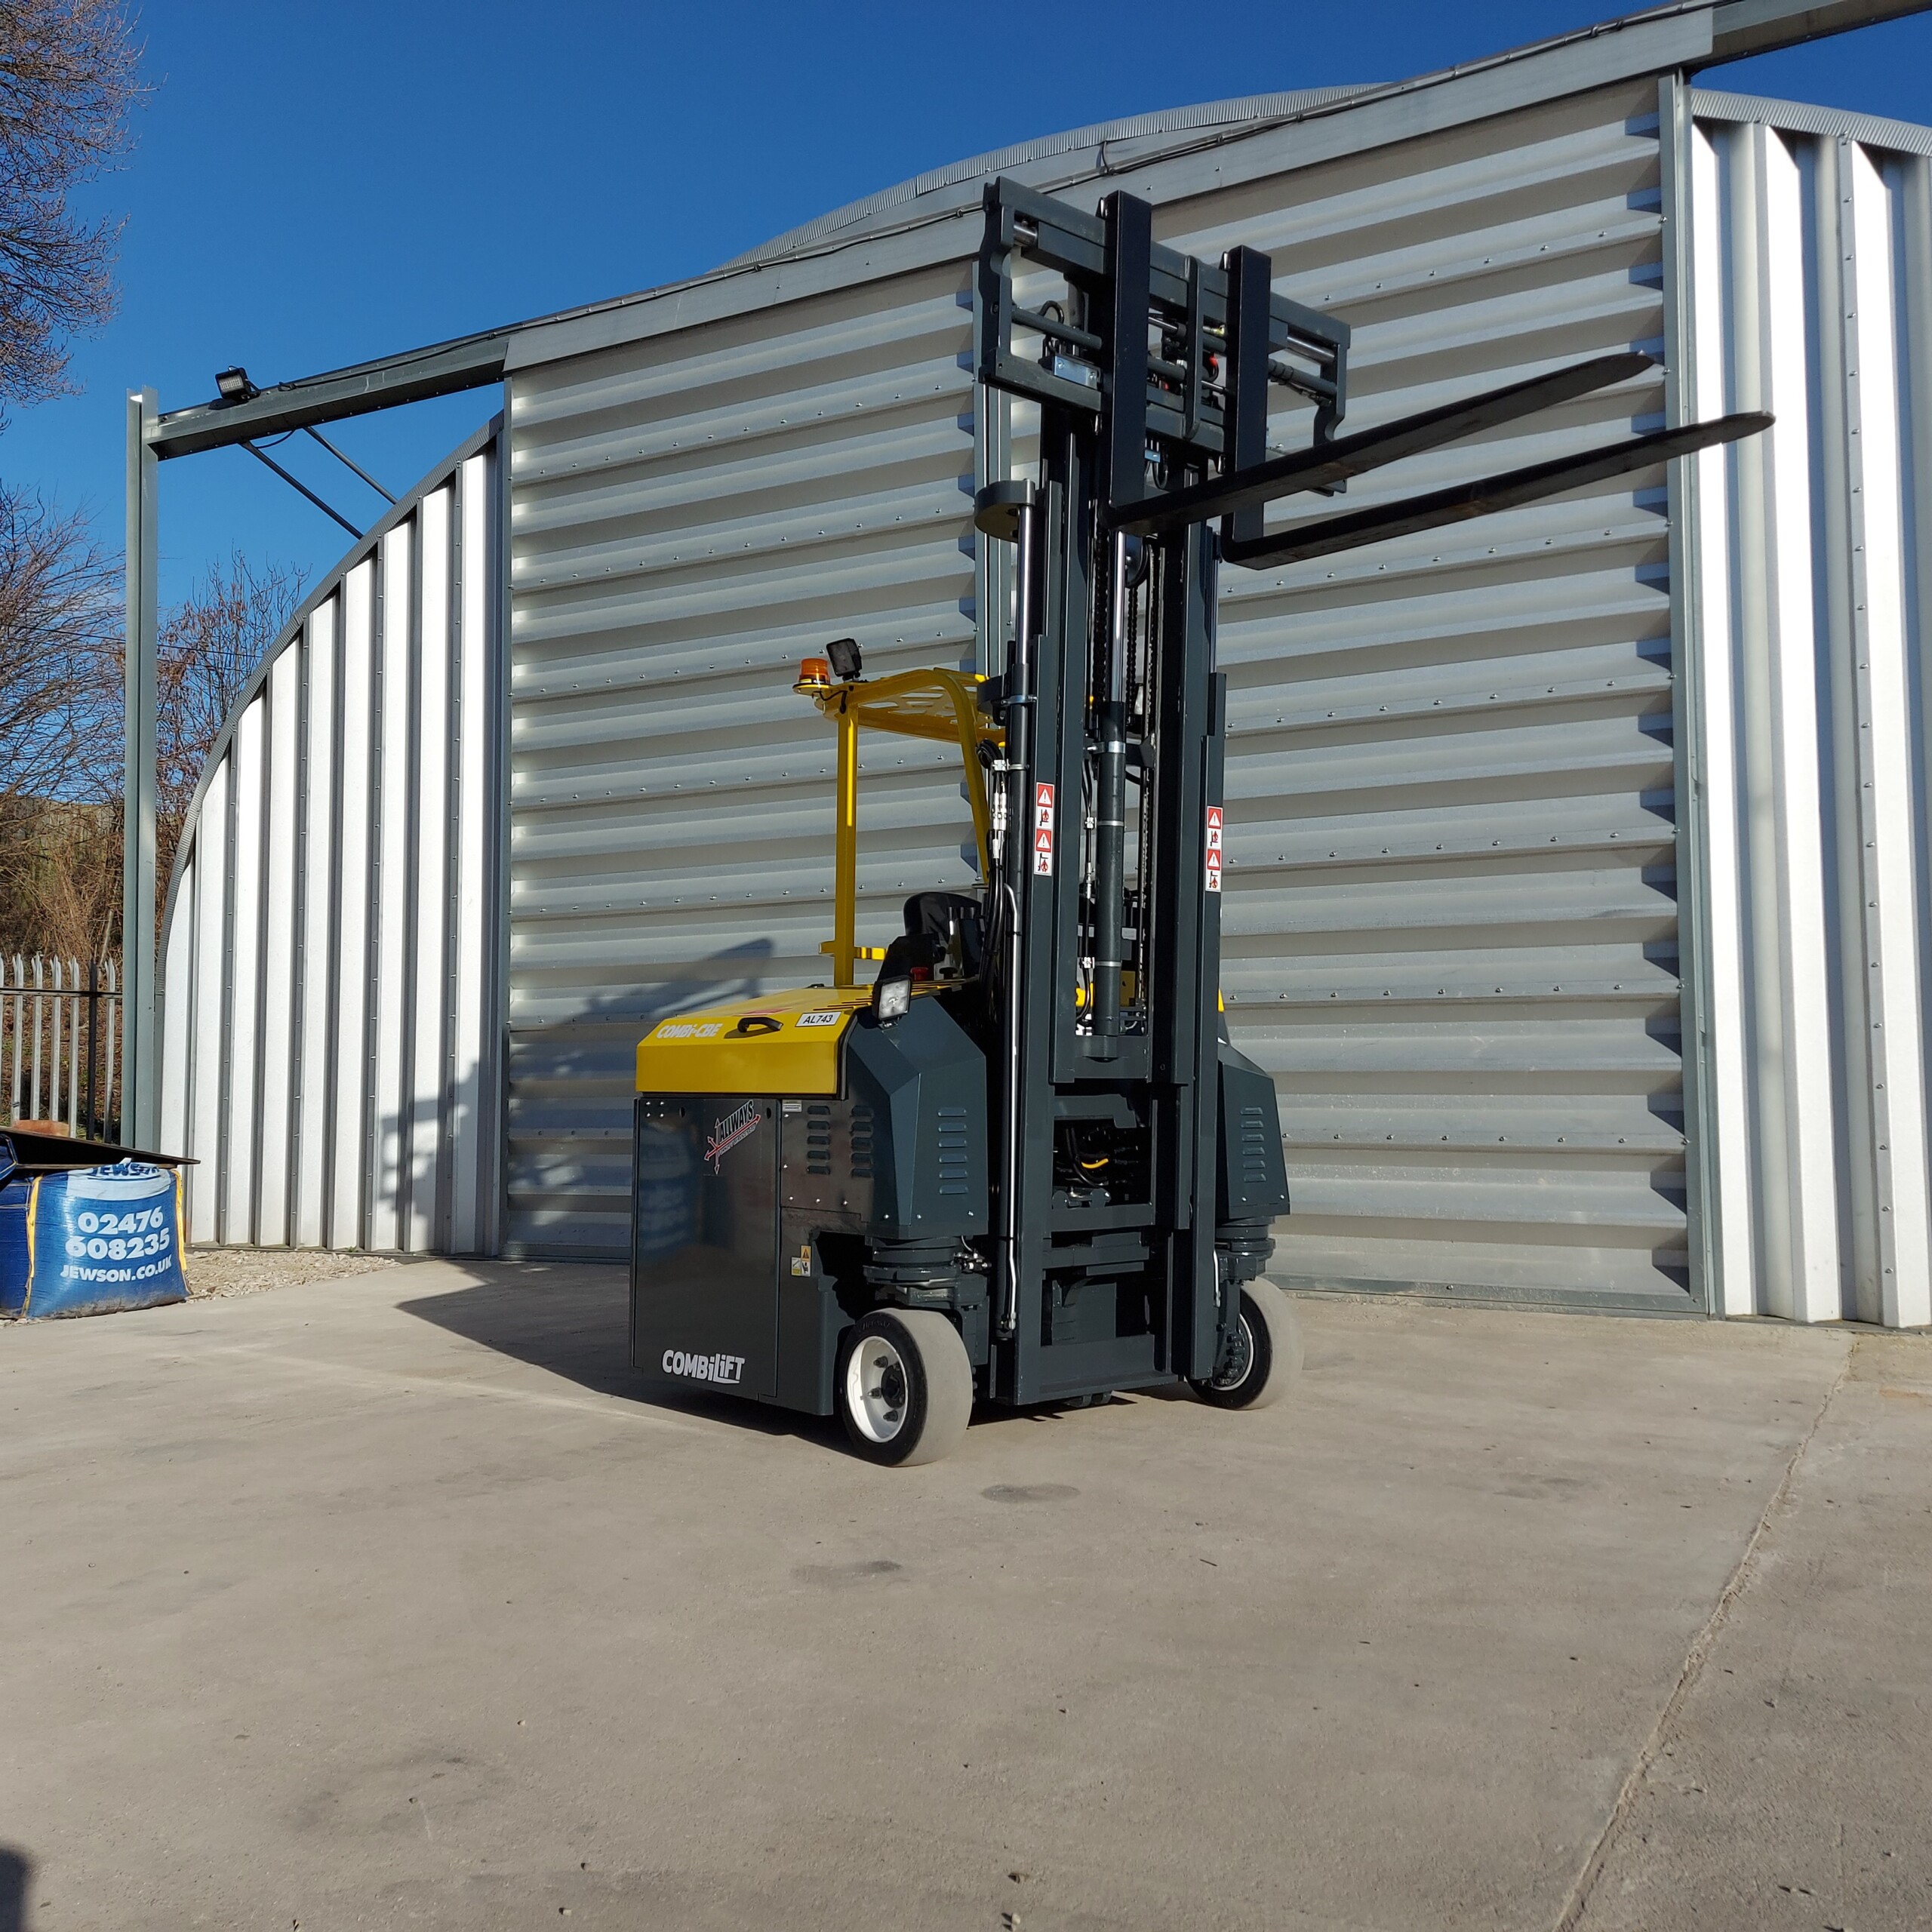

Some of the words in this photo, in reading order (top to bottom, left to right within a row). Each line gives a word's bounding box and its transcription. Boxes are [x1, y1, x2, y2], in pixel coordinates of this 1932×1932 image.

[803, 1014, 833, 1024] AL743
[719, 1100, 754, 1143] ALLWAYS
[78, 1207, 163, 1234] 02476
[66, 1228, 170, 1260] 608235
[60, 1255, 171, 1282] JEWSON.CO.UK
